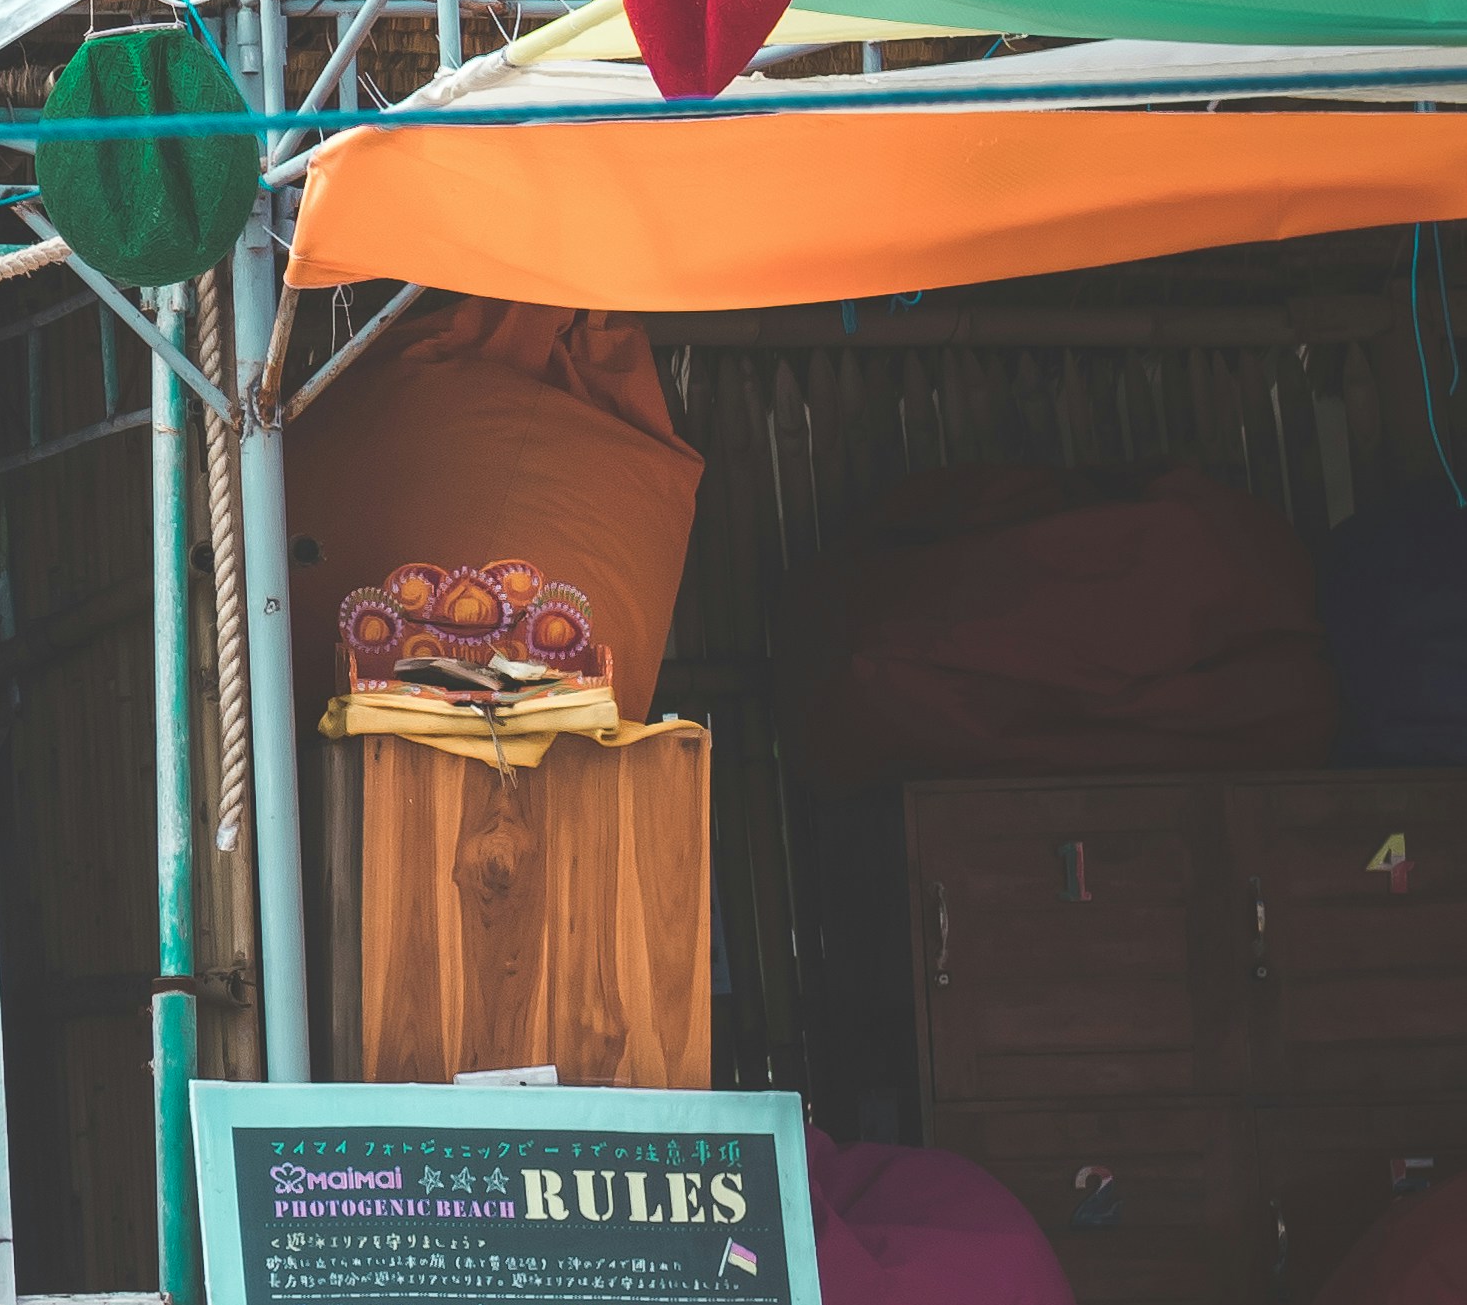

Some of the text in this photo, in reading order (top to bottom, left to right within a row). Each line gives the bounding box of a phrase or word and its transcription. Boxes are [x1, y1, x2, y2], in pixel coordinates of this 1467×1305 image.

[1057, 841, 1092, 902] 1
[1365, 833, 1414, 893] 4
[274, 1198, 517, 1220] PHOTOGENIC BEACH
[521, 1168, 748, 1224] RULES
[1070, 1165, 1123, 1231] 2
